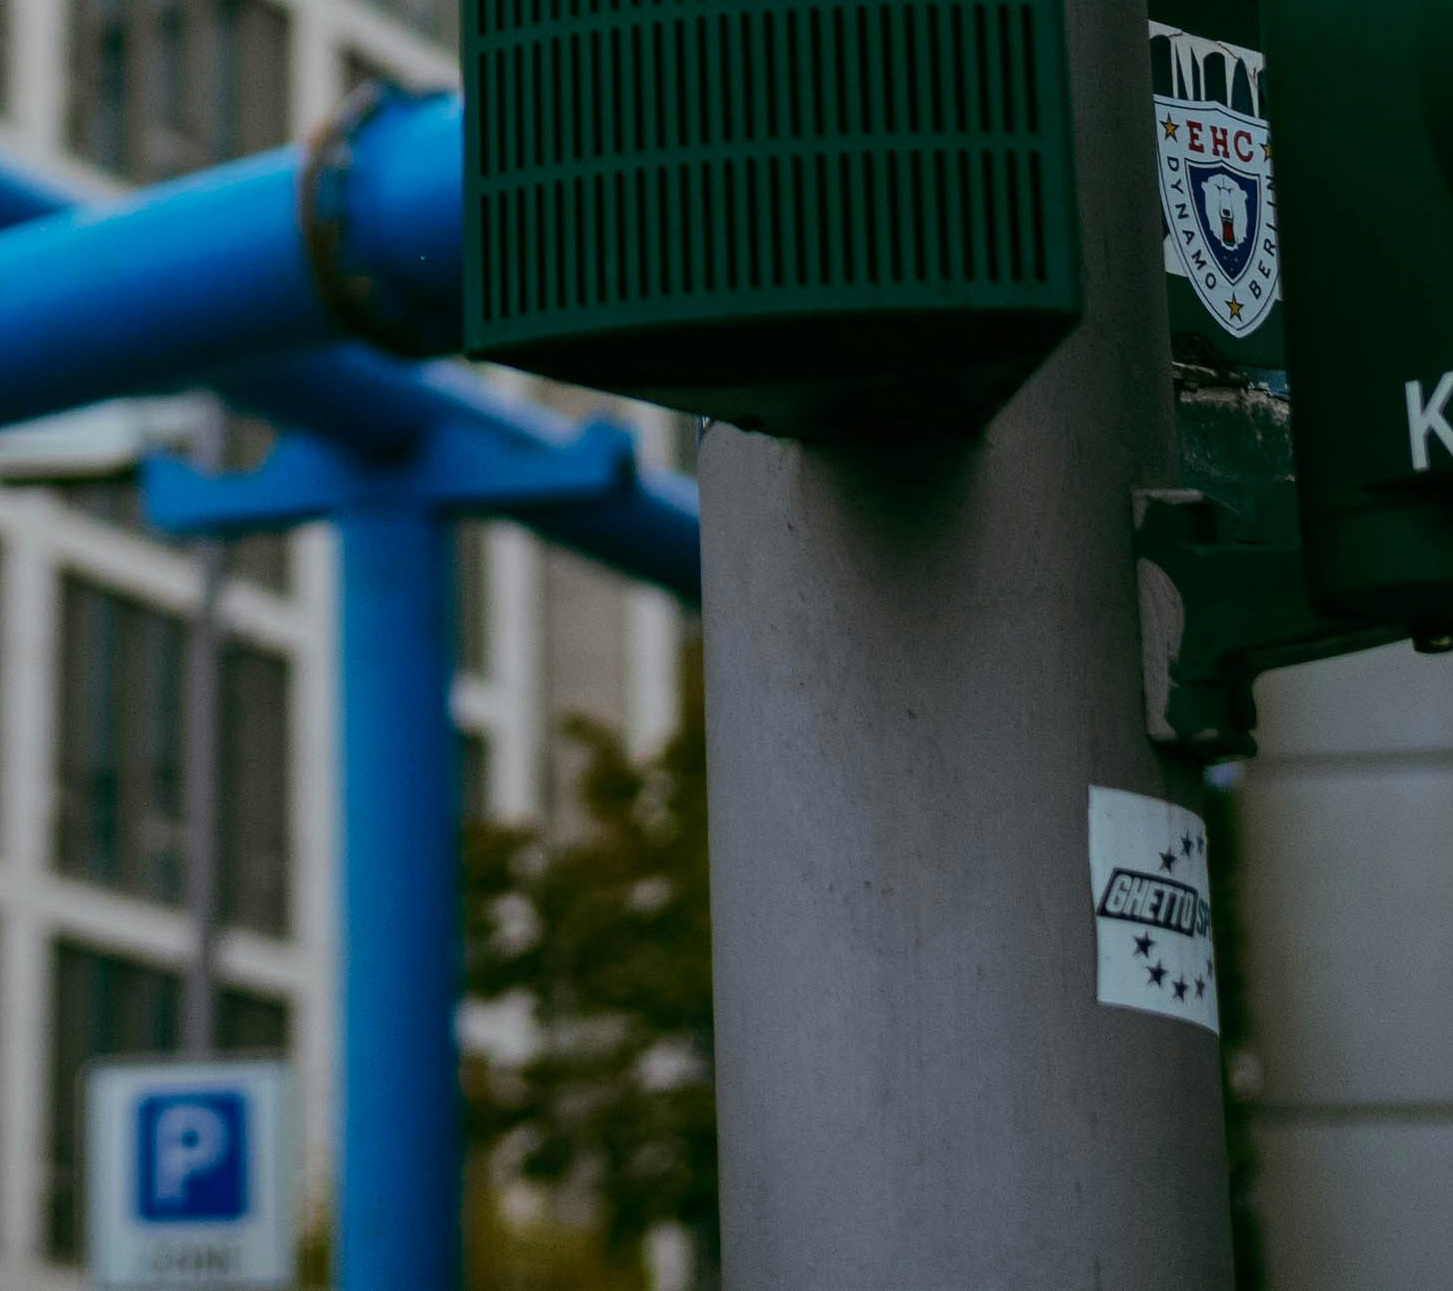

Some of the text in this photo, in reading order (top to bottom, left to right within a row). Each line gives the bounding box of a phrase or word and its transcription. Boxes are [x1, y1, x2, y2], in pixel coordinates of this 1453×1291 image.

[1185, 119, 1255, 163] EHC
[1166, 155, 1217, 291] DYNAMO
[1104, 873, 1196, 930] GHETTO
[153, 1103, 229, 1203] P
